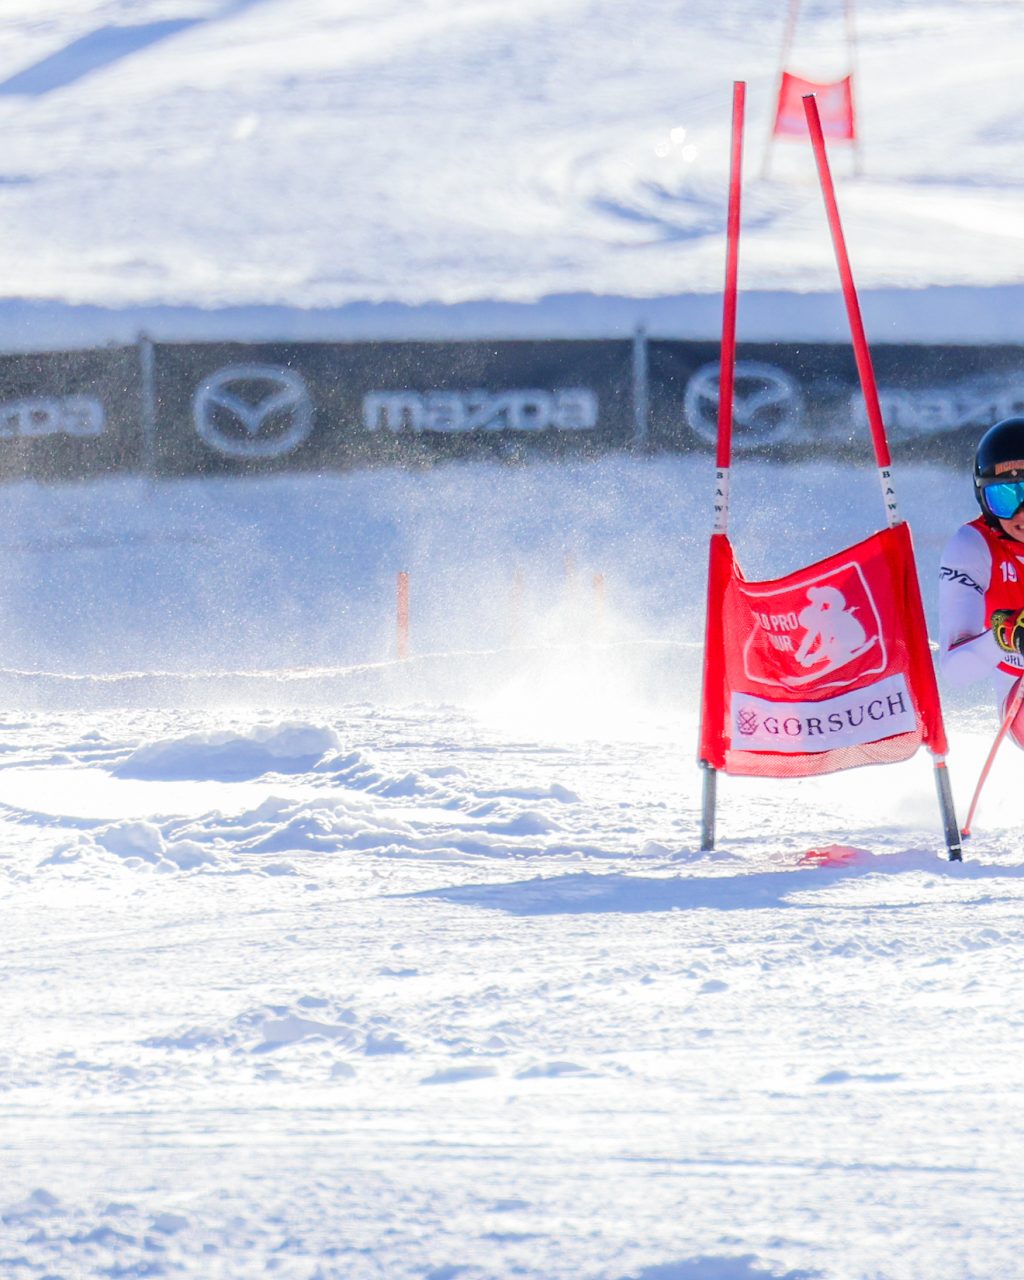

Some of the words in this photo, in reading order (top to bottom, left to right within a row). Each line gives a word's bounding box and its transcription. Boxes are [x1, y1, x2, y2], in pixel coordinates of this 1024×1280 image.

[362, 387, 598, 434] mazda
[999, 561, 1018, 583] 19
[770, 612, 799, 632] PRO
[763, 692, 908, 737] GORSUCH
